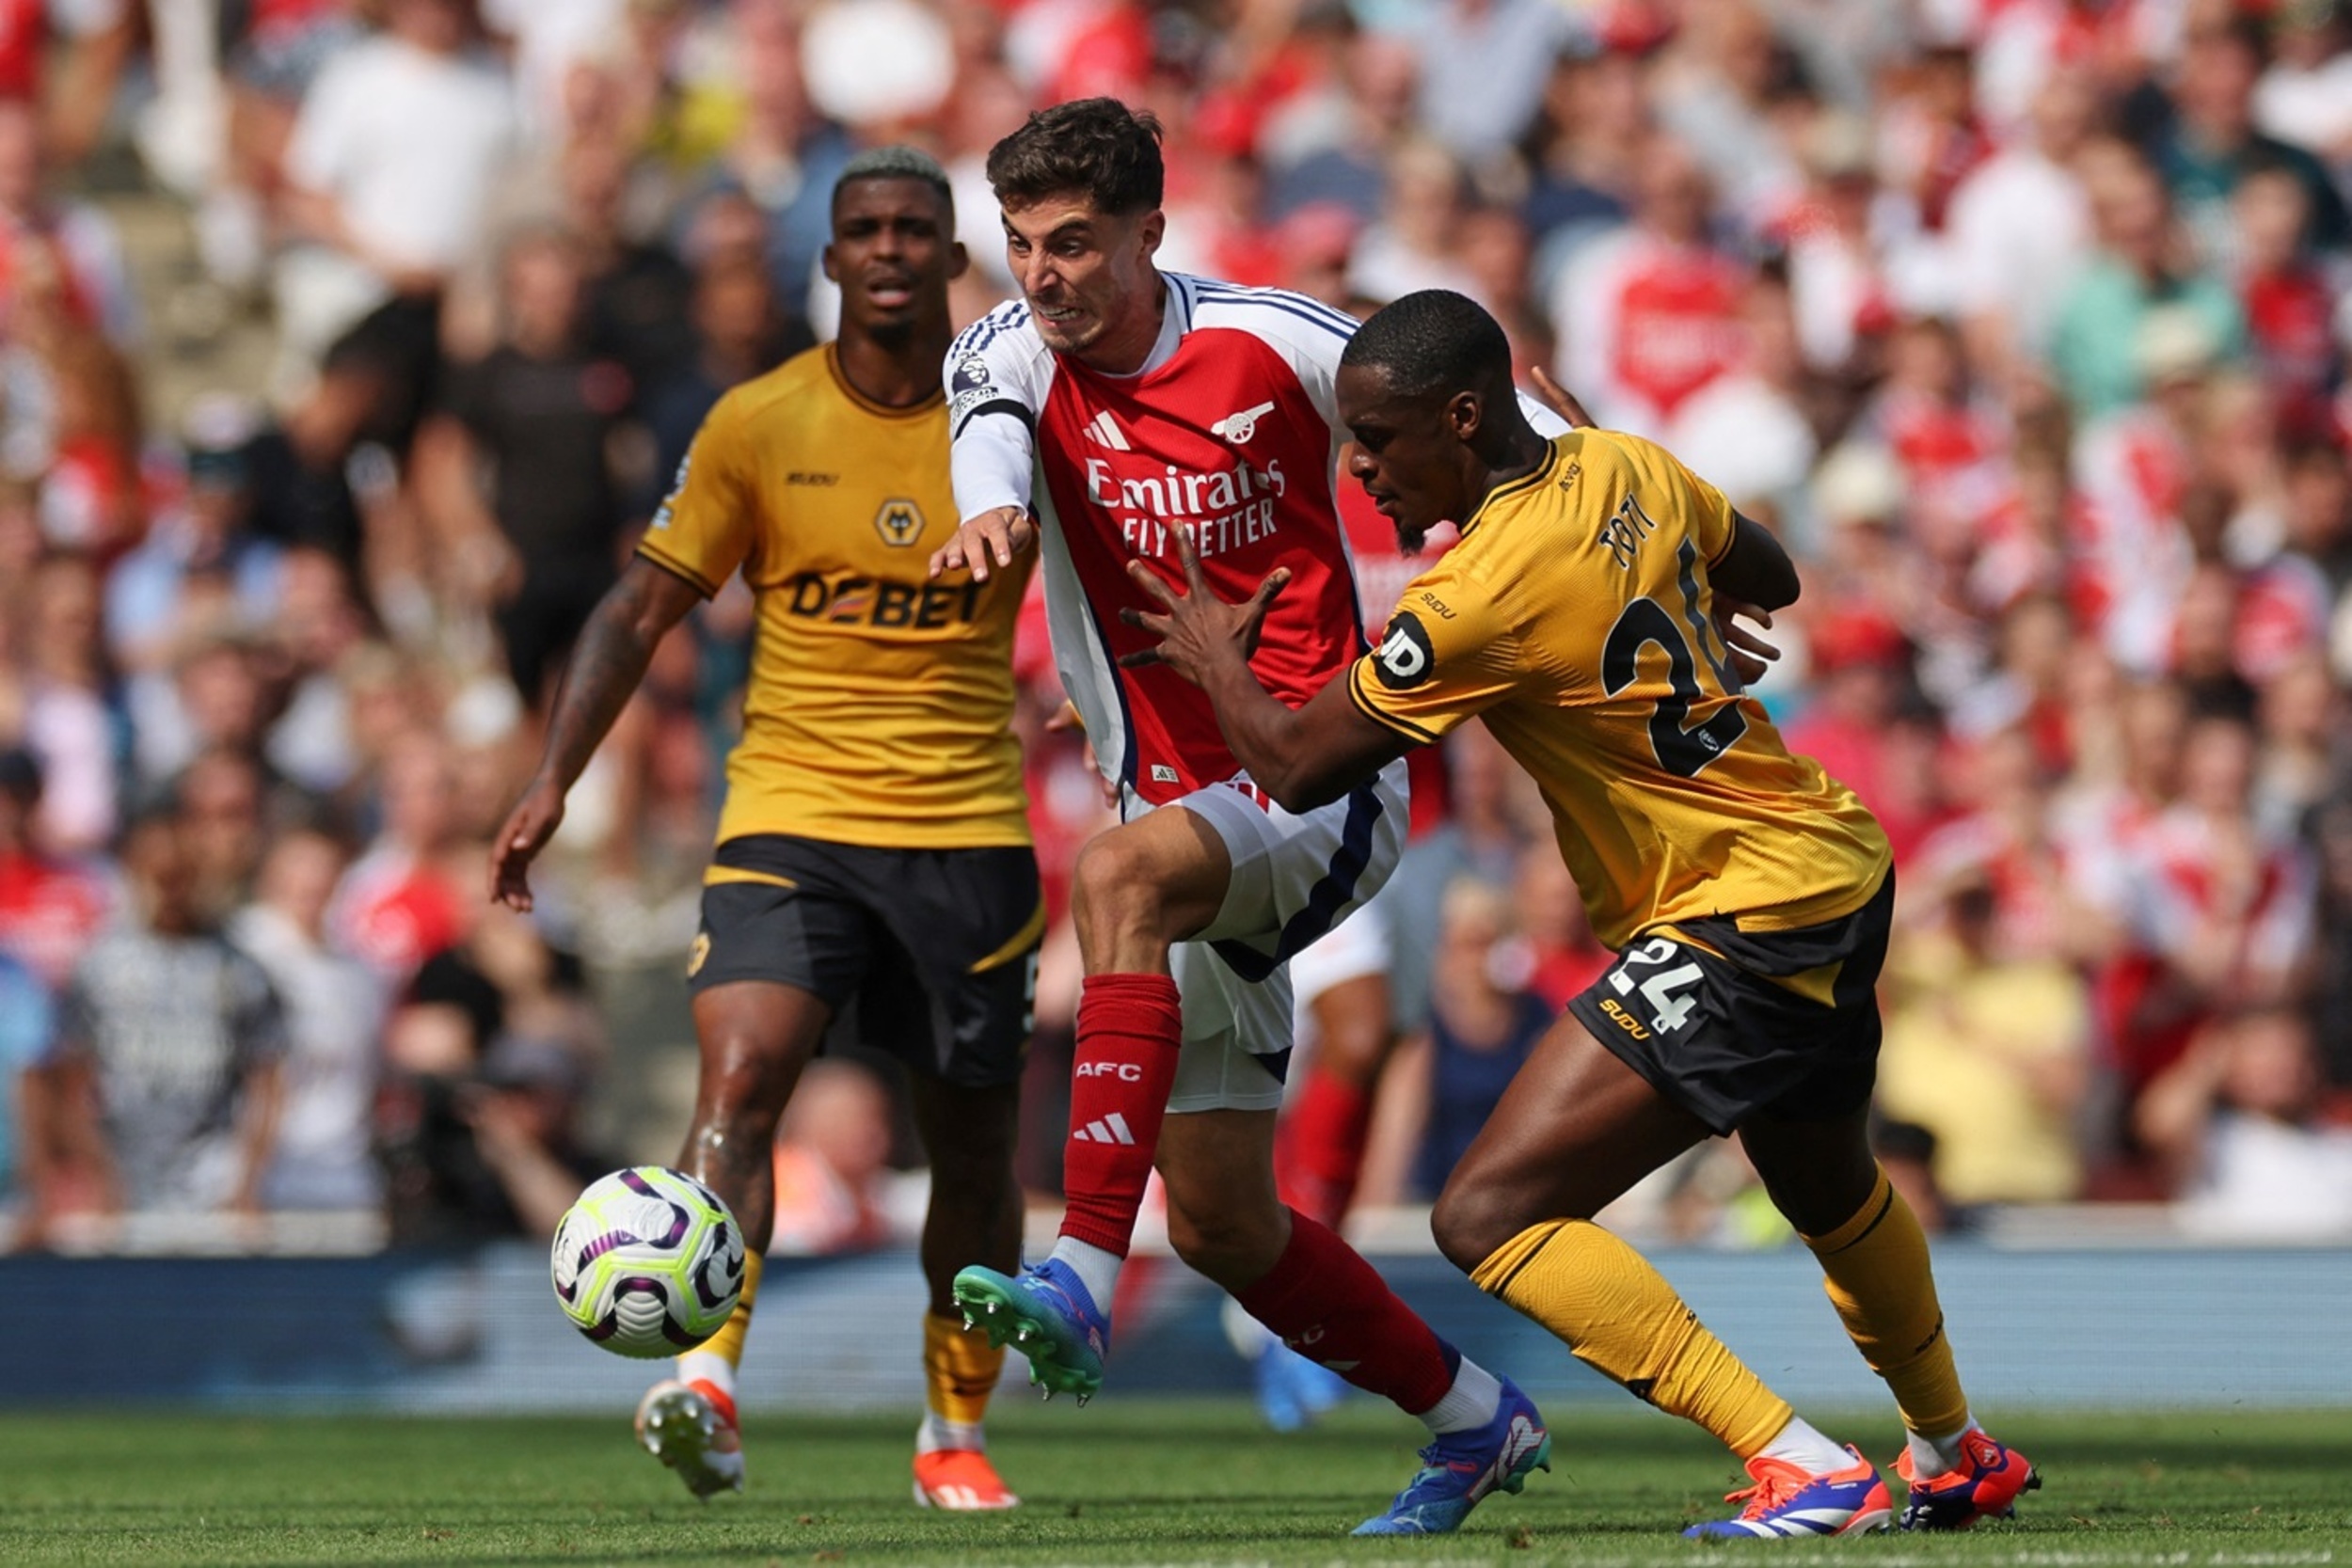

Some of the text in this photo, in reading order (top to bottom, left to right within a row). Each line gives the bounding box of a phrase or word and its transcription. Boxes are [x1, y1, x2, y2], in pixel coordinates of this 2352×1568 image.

[1122, 518, 1167, 558] FLY
[1599, 493, 1657, 570] TOTI
[790, 573, 980, 628] DEBET
[1420, 592, 1457, 620] SUDU
[1608, 938, 1705, 1035] 24
[1599, 998, 1650, 1040] SUDU
[1076, 1061, 1142, 1083] AFC
